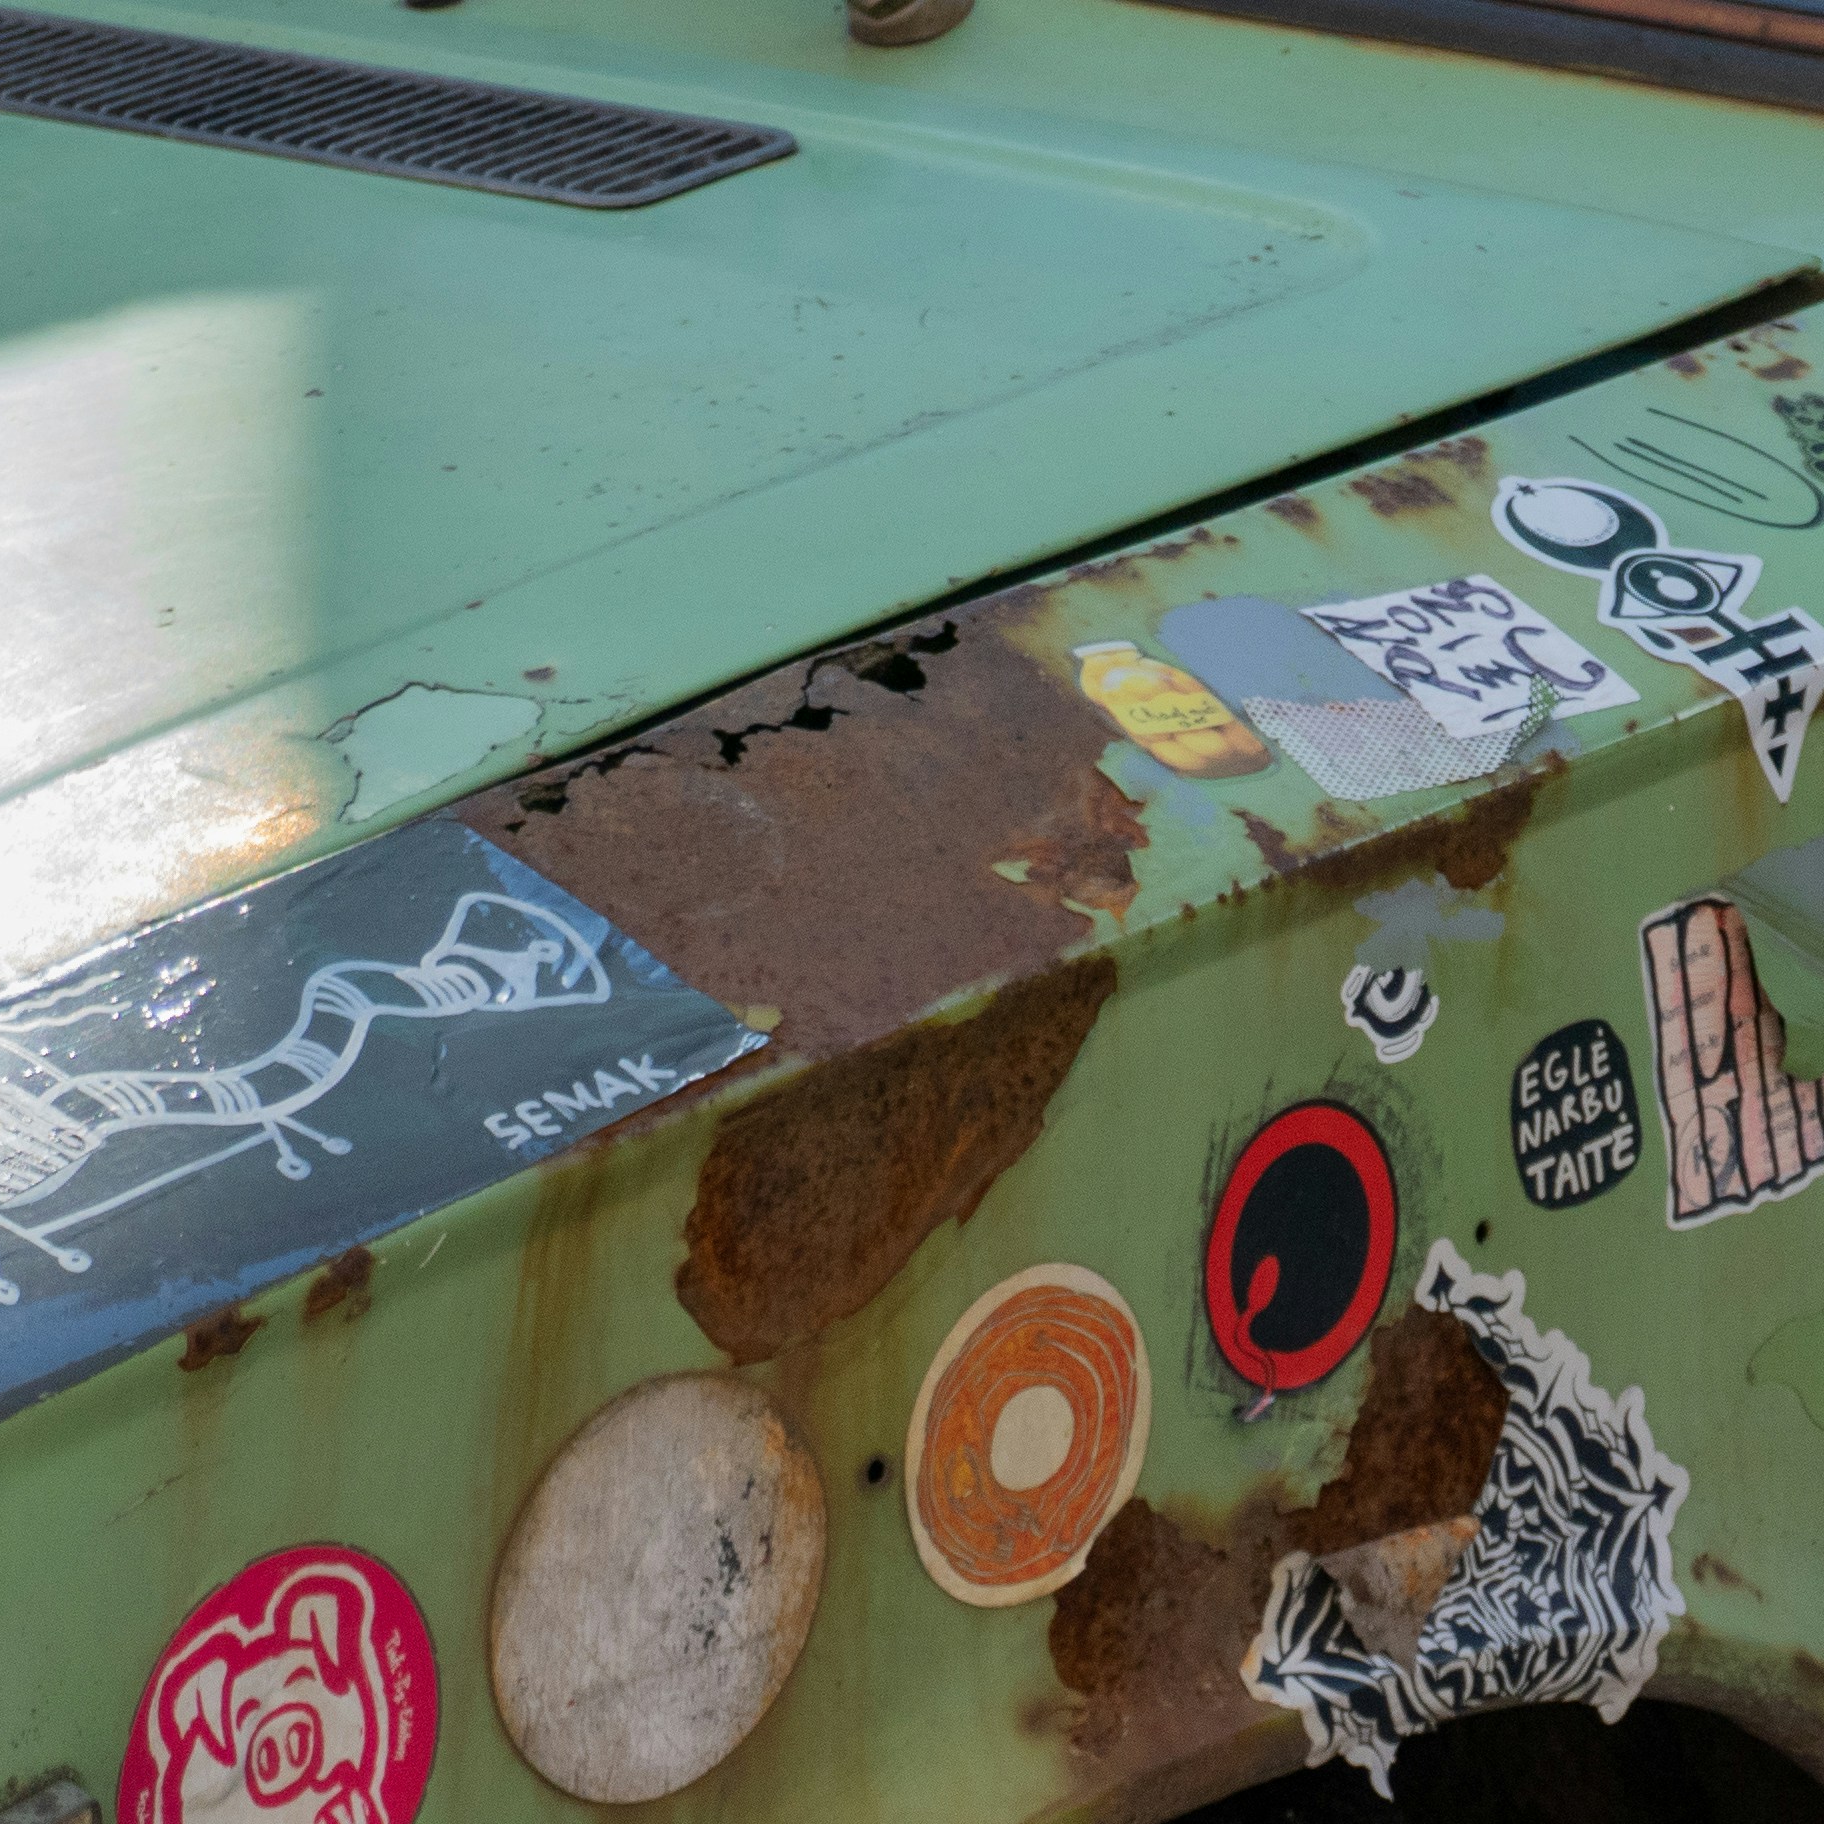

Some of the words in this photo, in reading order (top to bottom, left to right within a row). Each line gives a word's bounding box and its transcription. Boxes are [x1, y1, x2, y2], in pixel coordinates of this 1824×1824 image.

[483, 1053, 677, 1150] SEMAK
[1520, 1027, 1610, 1109] EGLĖ
[1519, 1079, 1624, 1154] NARBU
[1527, 1112, 1636, 1200] TAITĖ
